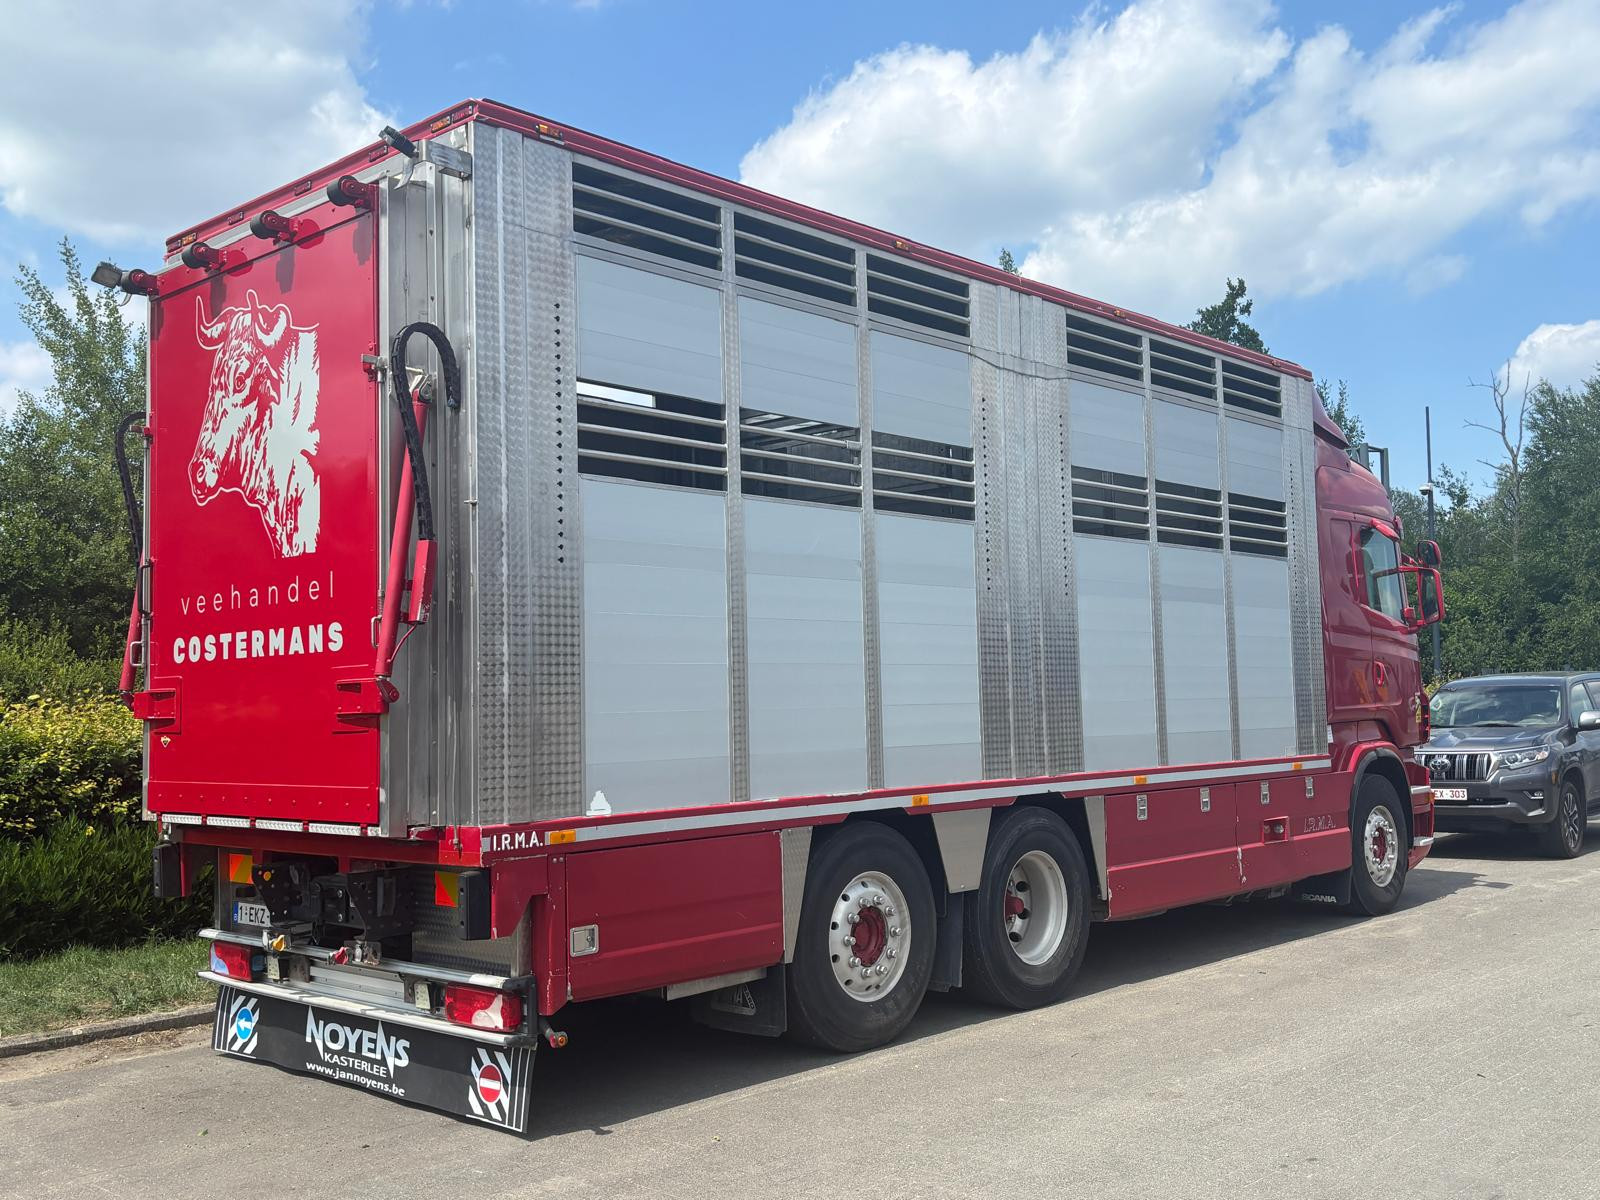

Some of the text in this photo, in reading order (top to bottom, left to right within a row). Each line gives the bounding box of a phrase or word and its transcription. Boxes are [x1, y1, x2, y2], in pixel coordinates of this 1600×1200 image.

[181, 570, 335, 615] veehandel
[173, 621, 344, 664] COSTERMANS
[1433, 790, 1465, 798] EX-303
[493, 830, 544, 852] I.R.M.A.
[1302, 893, 1337, 903] SCANIA
[305, 1005, 410, 1079] NOYENS
[305, 1061, 406, 1096] www.jannoyens.be
[324, 1052, 388, 1078] KASTERLEE
